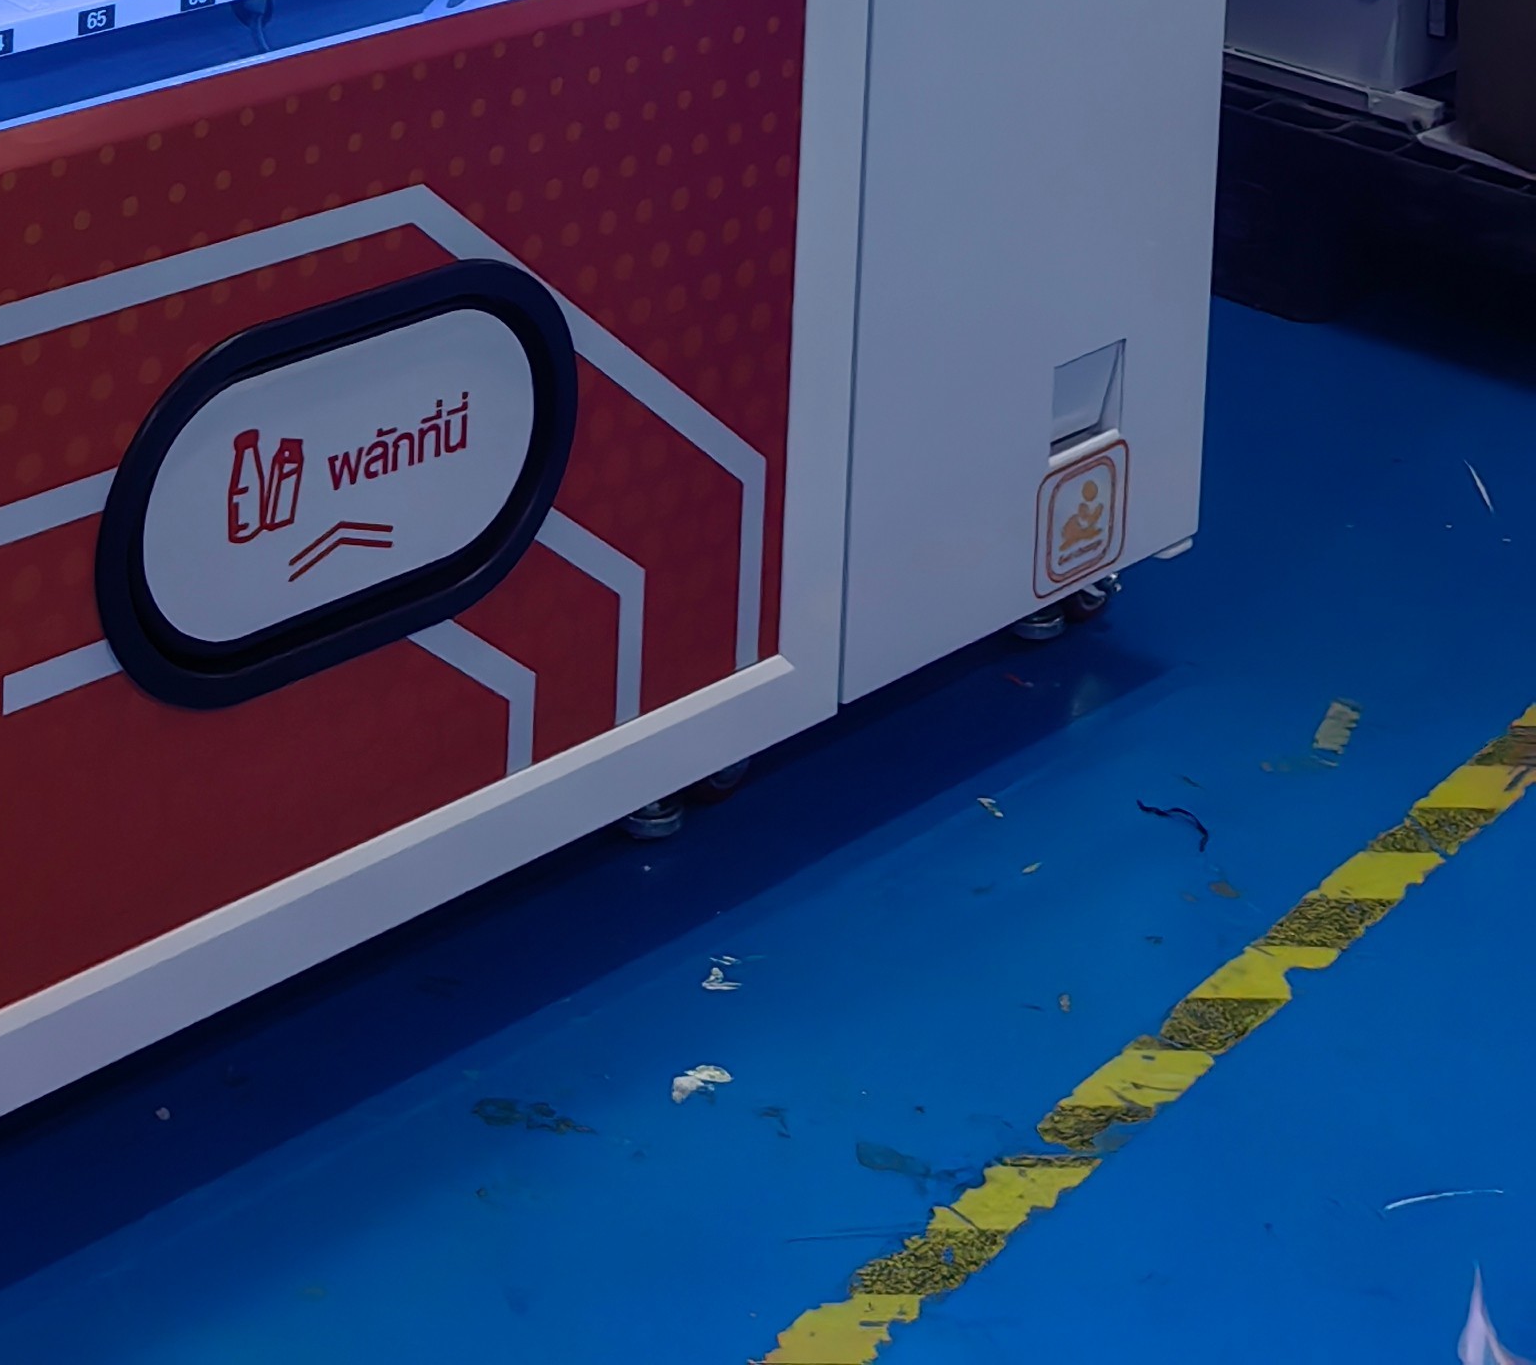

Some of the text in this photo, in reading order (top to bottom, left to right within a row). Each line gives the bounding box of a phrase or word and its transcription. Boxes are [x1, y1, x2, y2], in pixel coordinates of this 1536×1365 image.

[86, 9, 107, 30] 65
[328, 391, 470, 491] ผลักที่นี่
